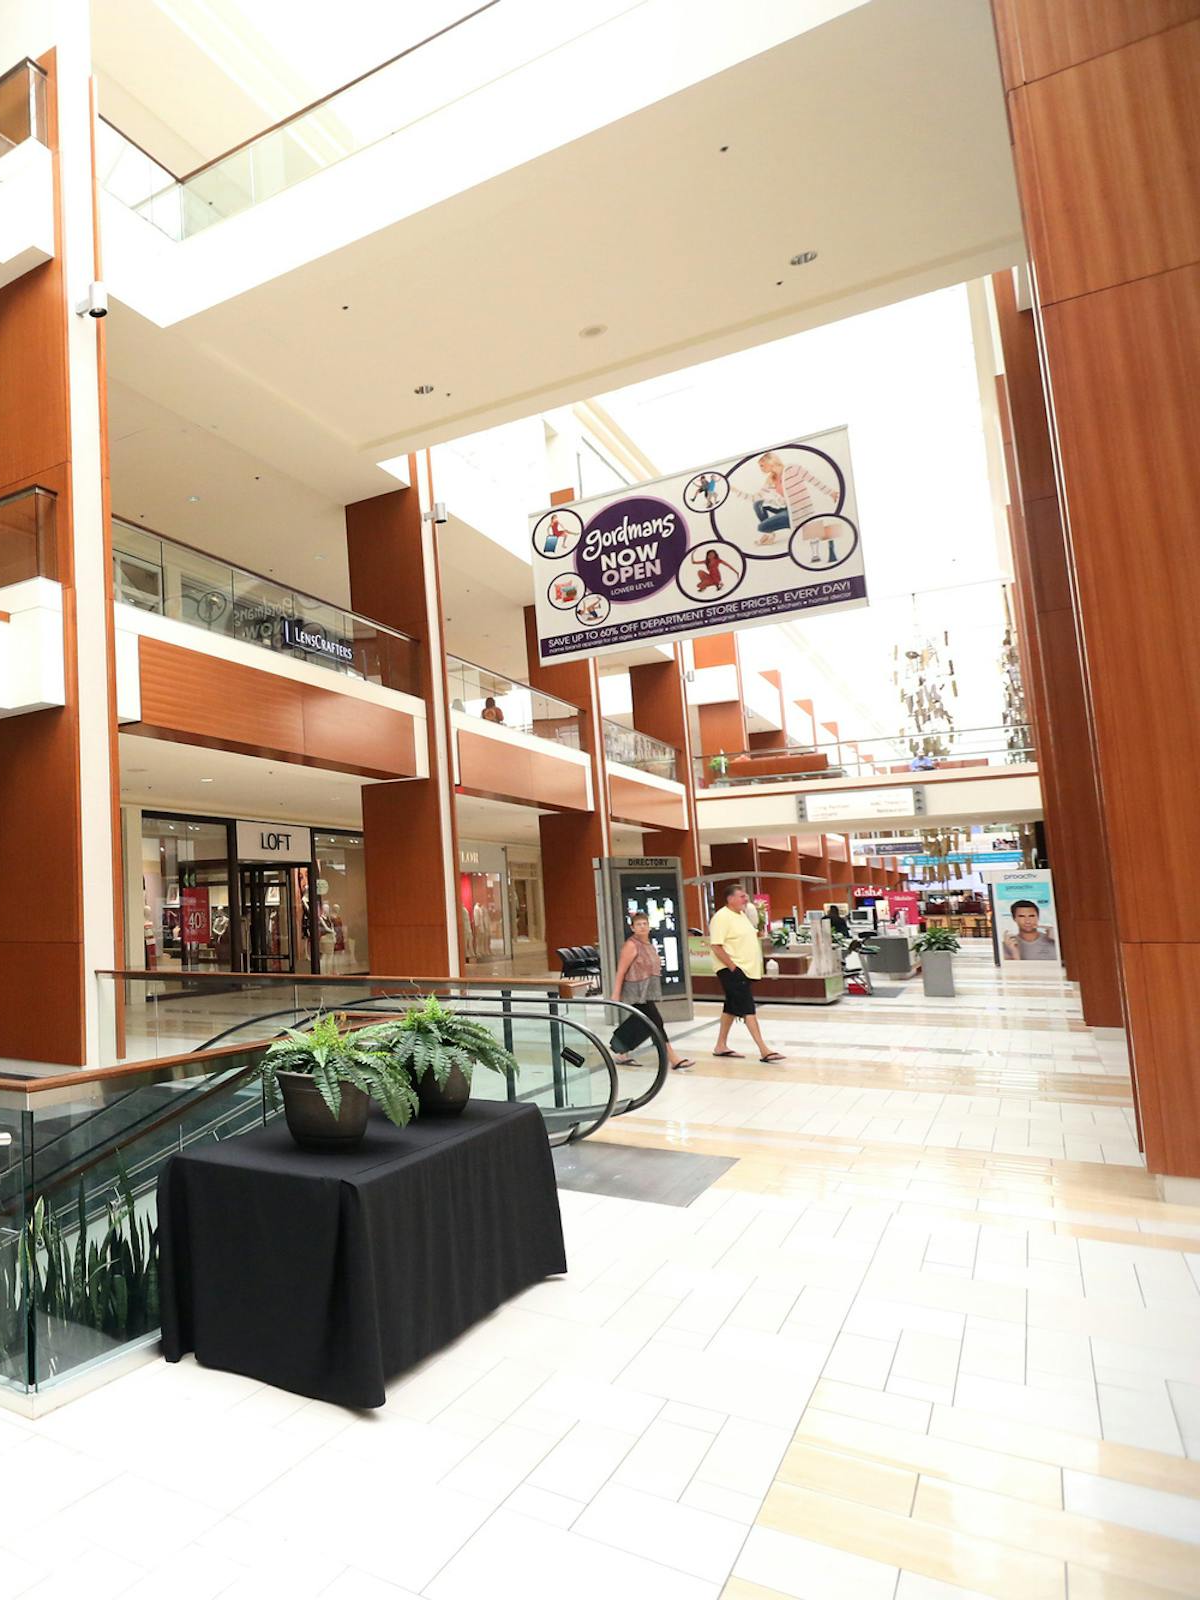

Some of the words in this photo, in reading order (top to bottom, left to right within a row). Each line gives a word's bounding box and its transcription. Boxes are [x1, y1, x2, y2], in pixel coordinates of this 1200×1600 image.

[582, 513, 675, 562] gordmans
[601, 542, 658, 571] NOW
[602, 559, 661, 586] OPEN
[610, 586, 635, 596] LOWER
[636, 581, 654, 591] LEVEL
[548, 635, 571, 648] SAVE
[572, 632, 585, 644] UP
[585, 630, 598, 642] TO
[600, 626, 619, 638] 60%
[620, 622, 638, 635] OFF
[640, 609, 705, 631] DEPARTMENT
[706, 601, 740, 617] STORE
[784, 586, 820, 602] EVERY
[822, 580, 850, 594] DAY!
[261, 832, 291, 850] LOFT
[628, 858, 668, 866] DIRECTORY
